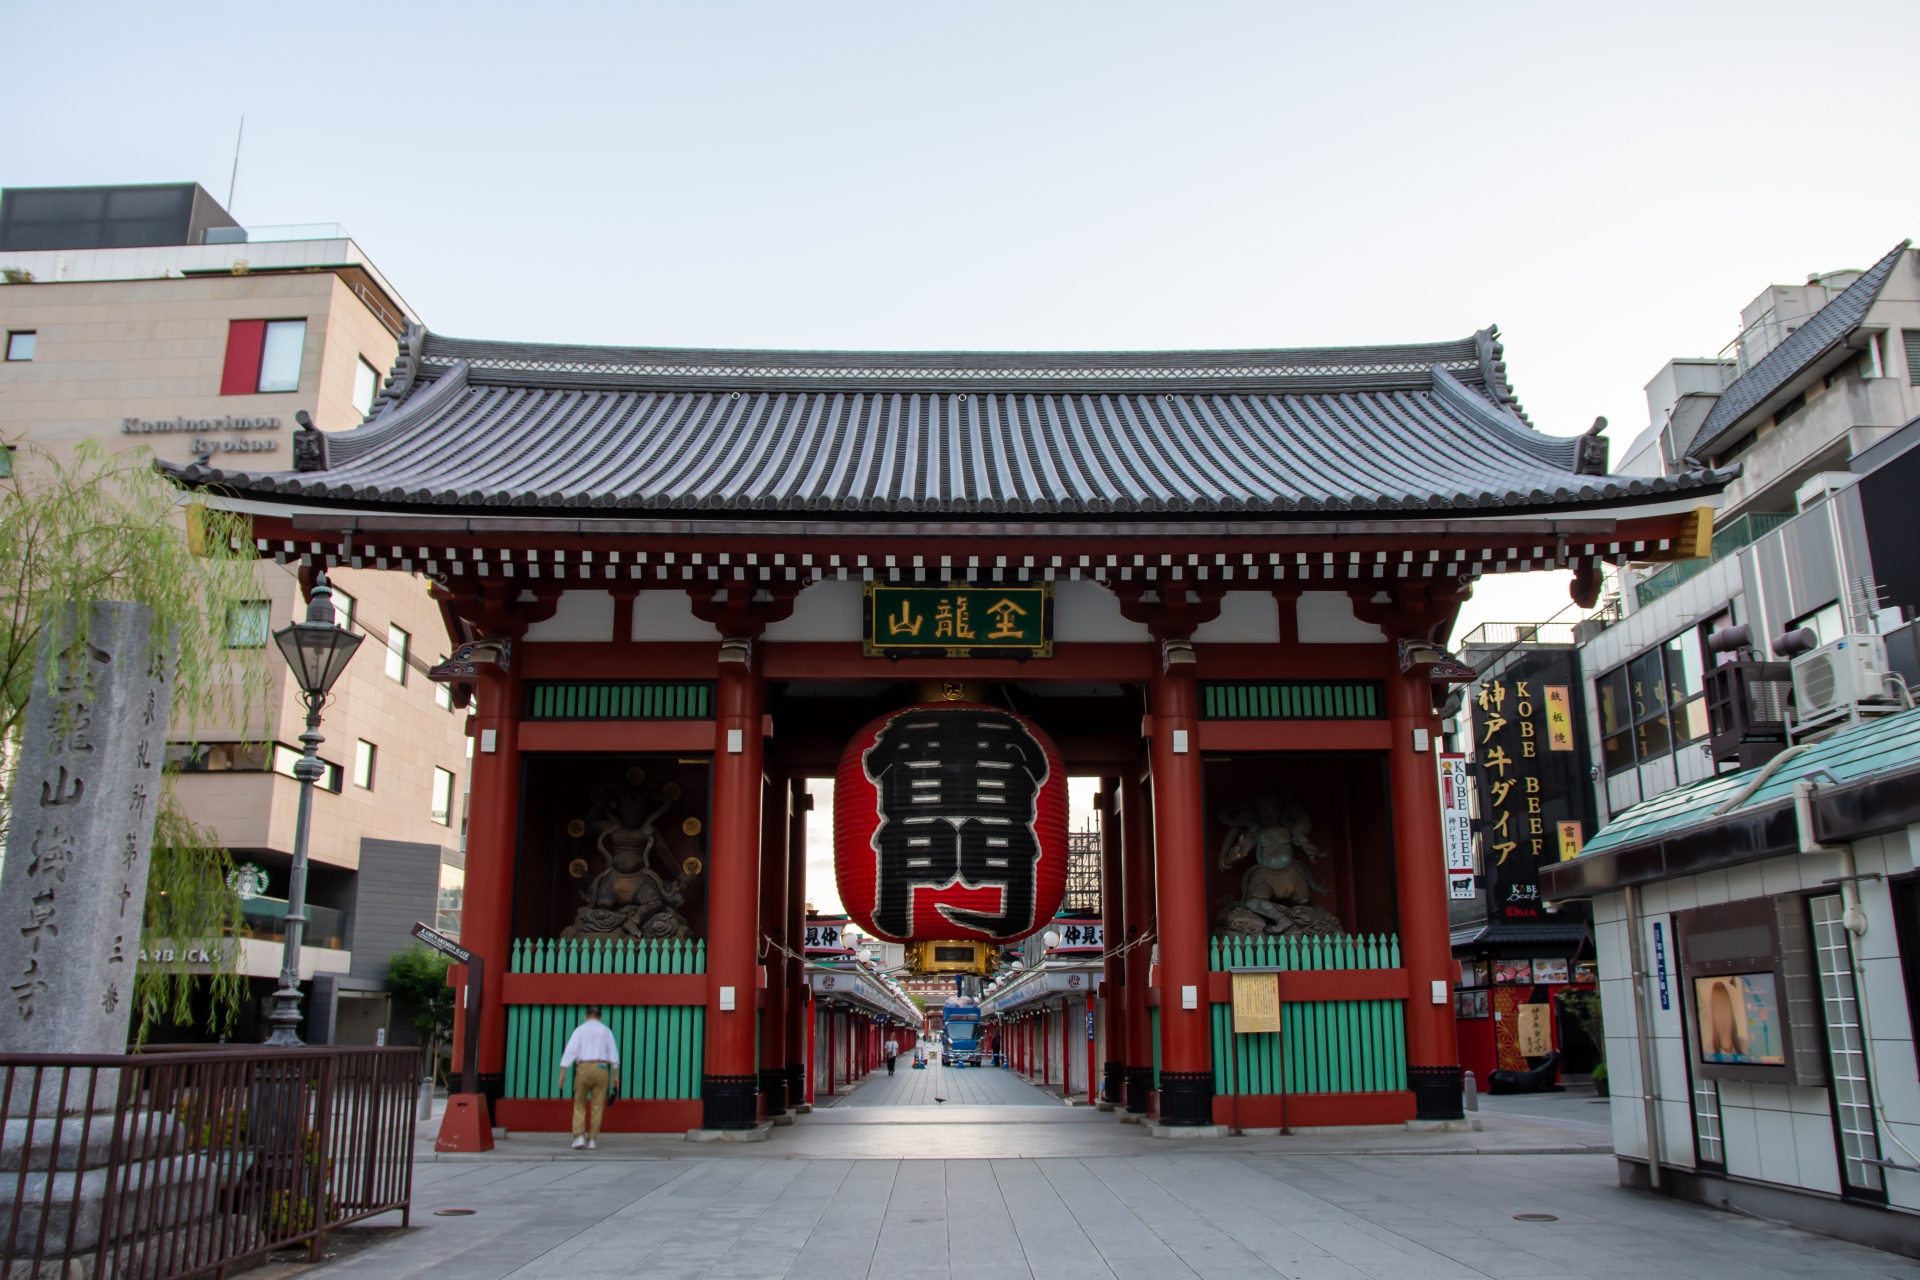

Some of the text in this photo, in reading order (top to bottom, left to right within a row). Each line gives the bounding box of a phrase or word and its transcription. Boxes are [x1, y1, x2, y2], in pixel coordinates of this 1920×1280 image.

[121, 414, 281, 434] Kaminarimon
[190, 436, 278, 454] Ryokan
[887, 596, 1028, 640] 金龍山
[1550, 690, 1567, 745] 鉄板焼
[1454, 760, 1467, 811] KOBE
[1477, 680, 1517, 867] 神戸牛ダイア
[1516, 681, 1544, 856] KOBE BEEF
[861, 706, 1051, 940] 雷門
[1448, 816, 1459, 867] 神戸牛ダイア
[1458, 816, 1471, 867] BEEF
[1563, 825, 1577, 862] 雷門
[421, 928, 457, 951] KAMINARIMON
[455, 948, 471, 959] GATE
